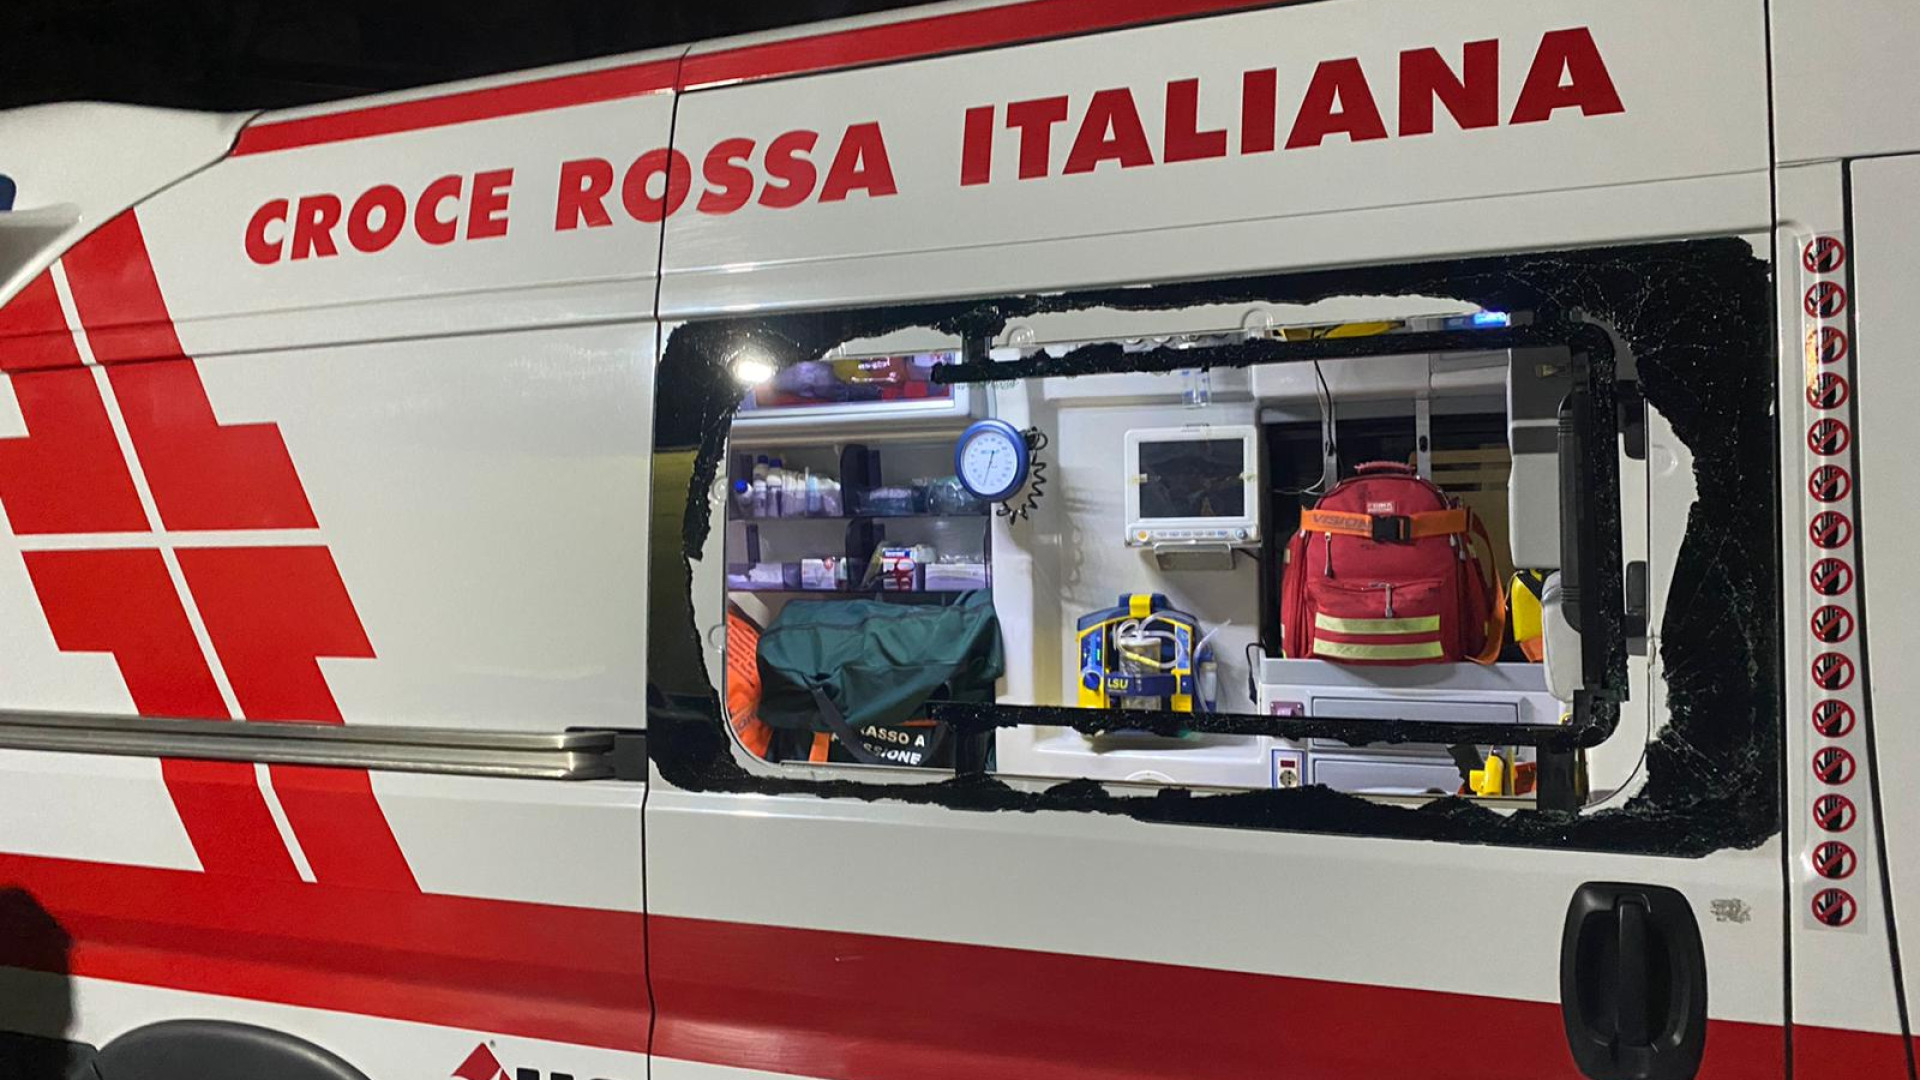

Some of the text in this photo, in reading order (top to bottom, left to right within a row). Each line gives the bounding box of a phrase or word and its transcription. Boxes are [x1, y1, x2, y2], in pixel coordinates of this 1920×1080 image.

[245, 26, 1626, 265] CROCE ROSSA ITALIANA
[1107, 678, 1128, 690] LSU
[914, 734, 925, 747] A
